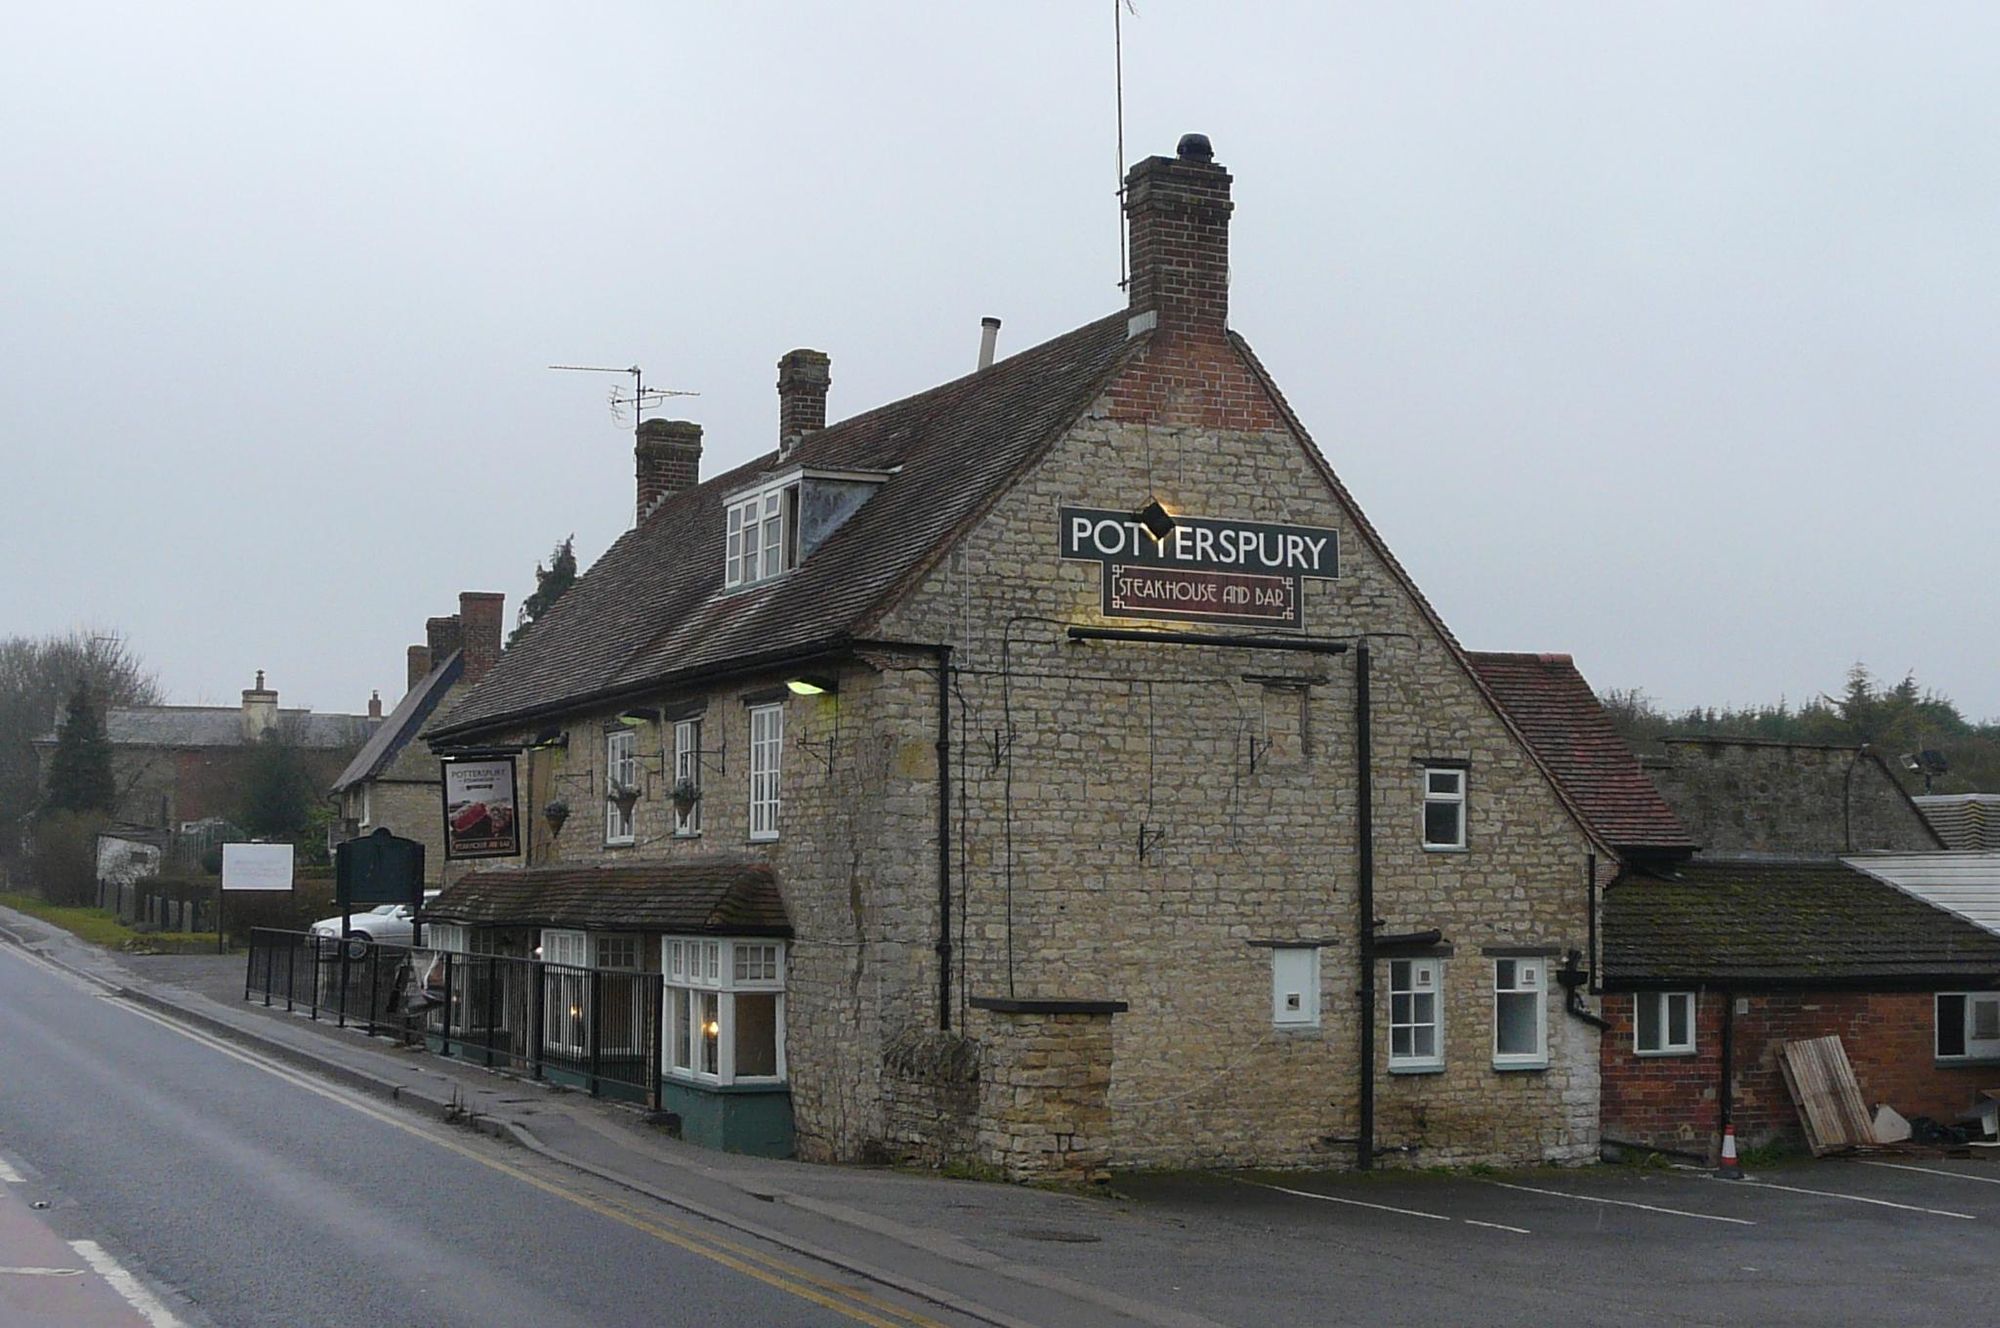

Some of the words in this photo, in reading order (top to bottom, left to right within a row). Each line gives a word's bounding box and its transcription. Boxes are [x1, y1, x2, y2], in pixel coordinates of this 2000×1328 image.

[1119, 578, 1217, 602] STEAKHOUSE
[1223, 585, 1250, 604] AND
[1255, 587, 1284, 607] BAR
